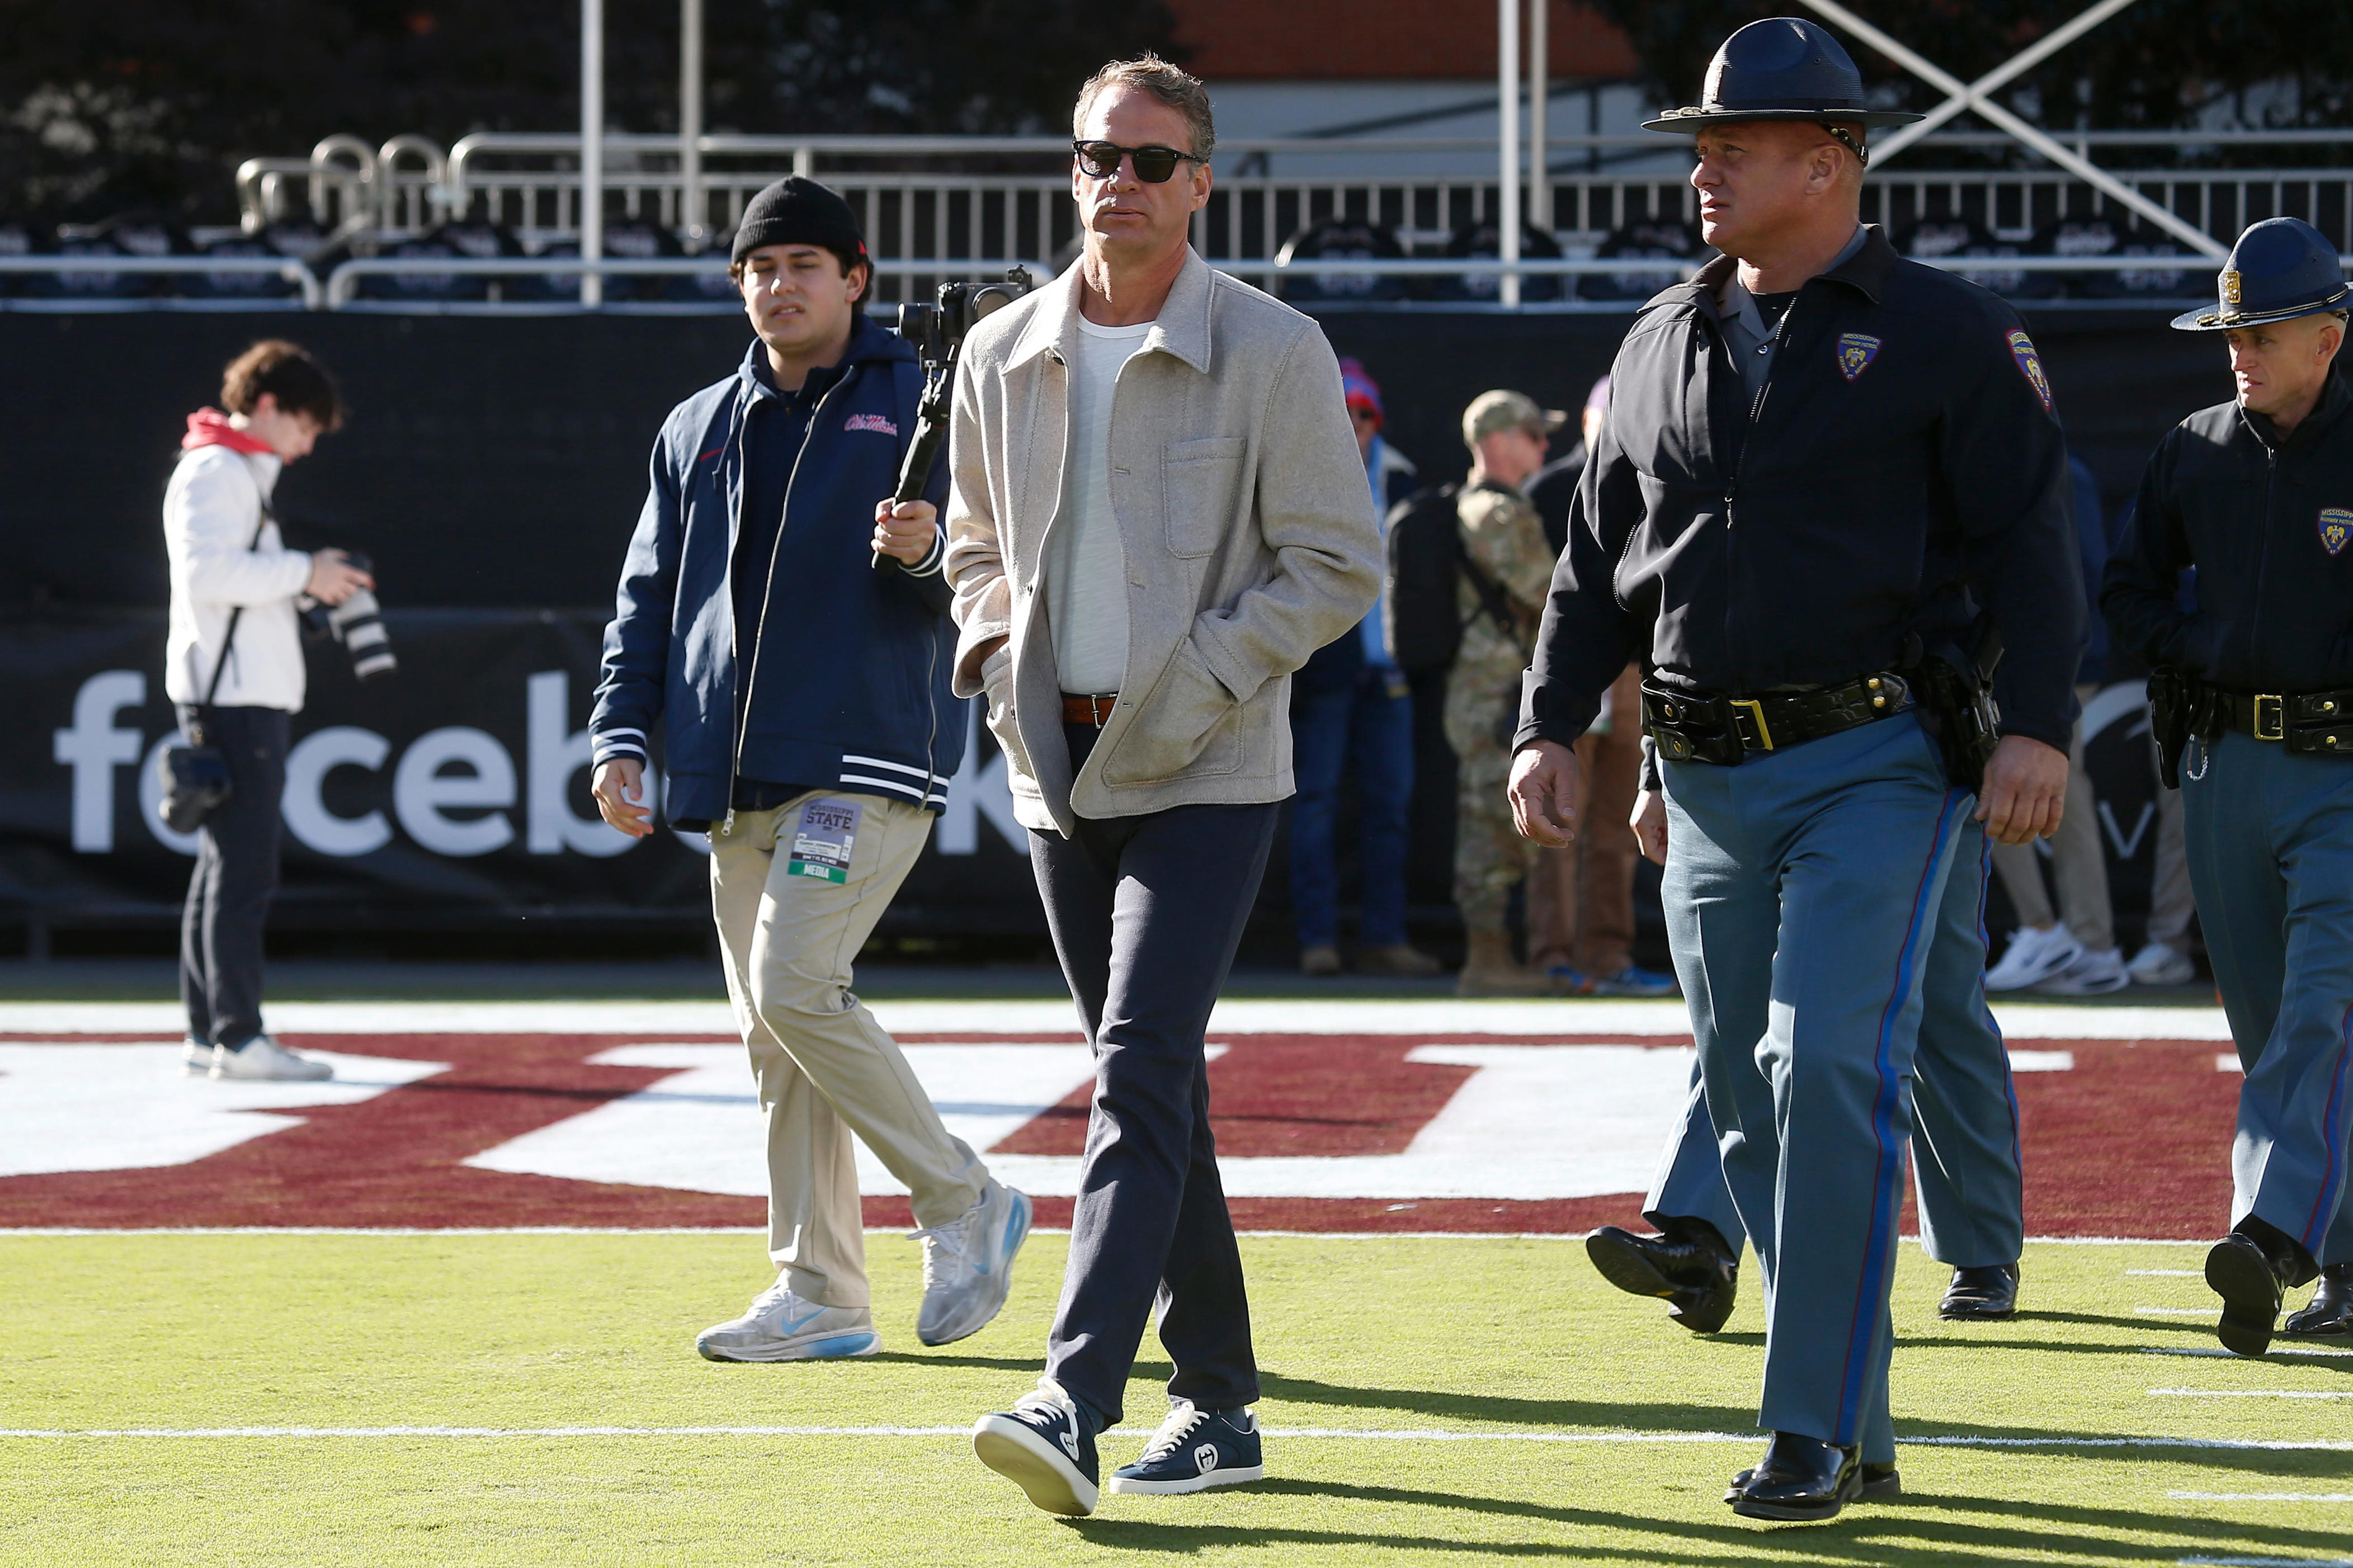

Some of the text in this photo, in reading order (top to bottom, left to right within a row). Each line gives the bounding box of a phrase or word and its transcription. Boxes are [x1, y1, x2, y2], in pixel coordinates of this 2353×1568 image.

[2322, 509, 2353, 519] MISSISSIPP
[54, 670, 1030, 858] fcebk
[806, 812, 852, 830] STATE
[803, 864, 829, 879] MEDIA
